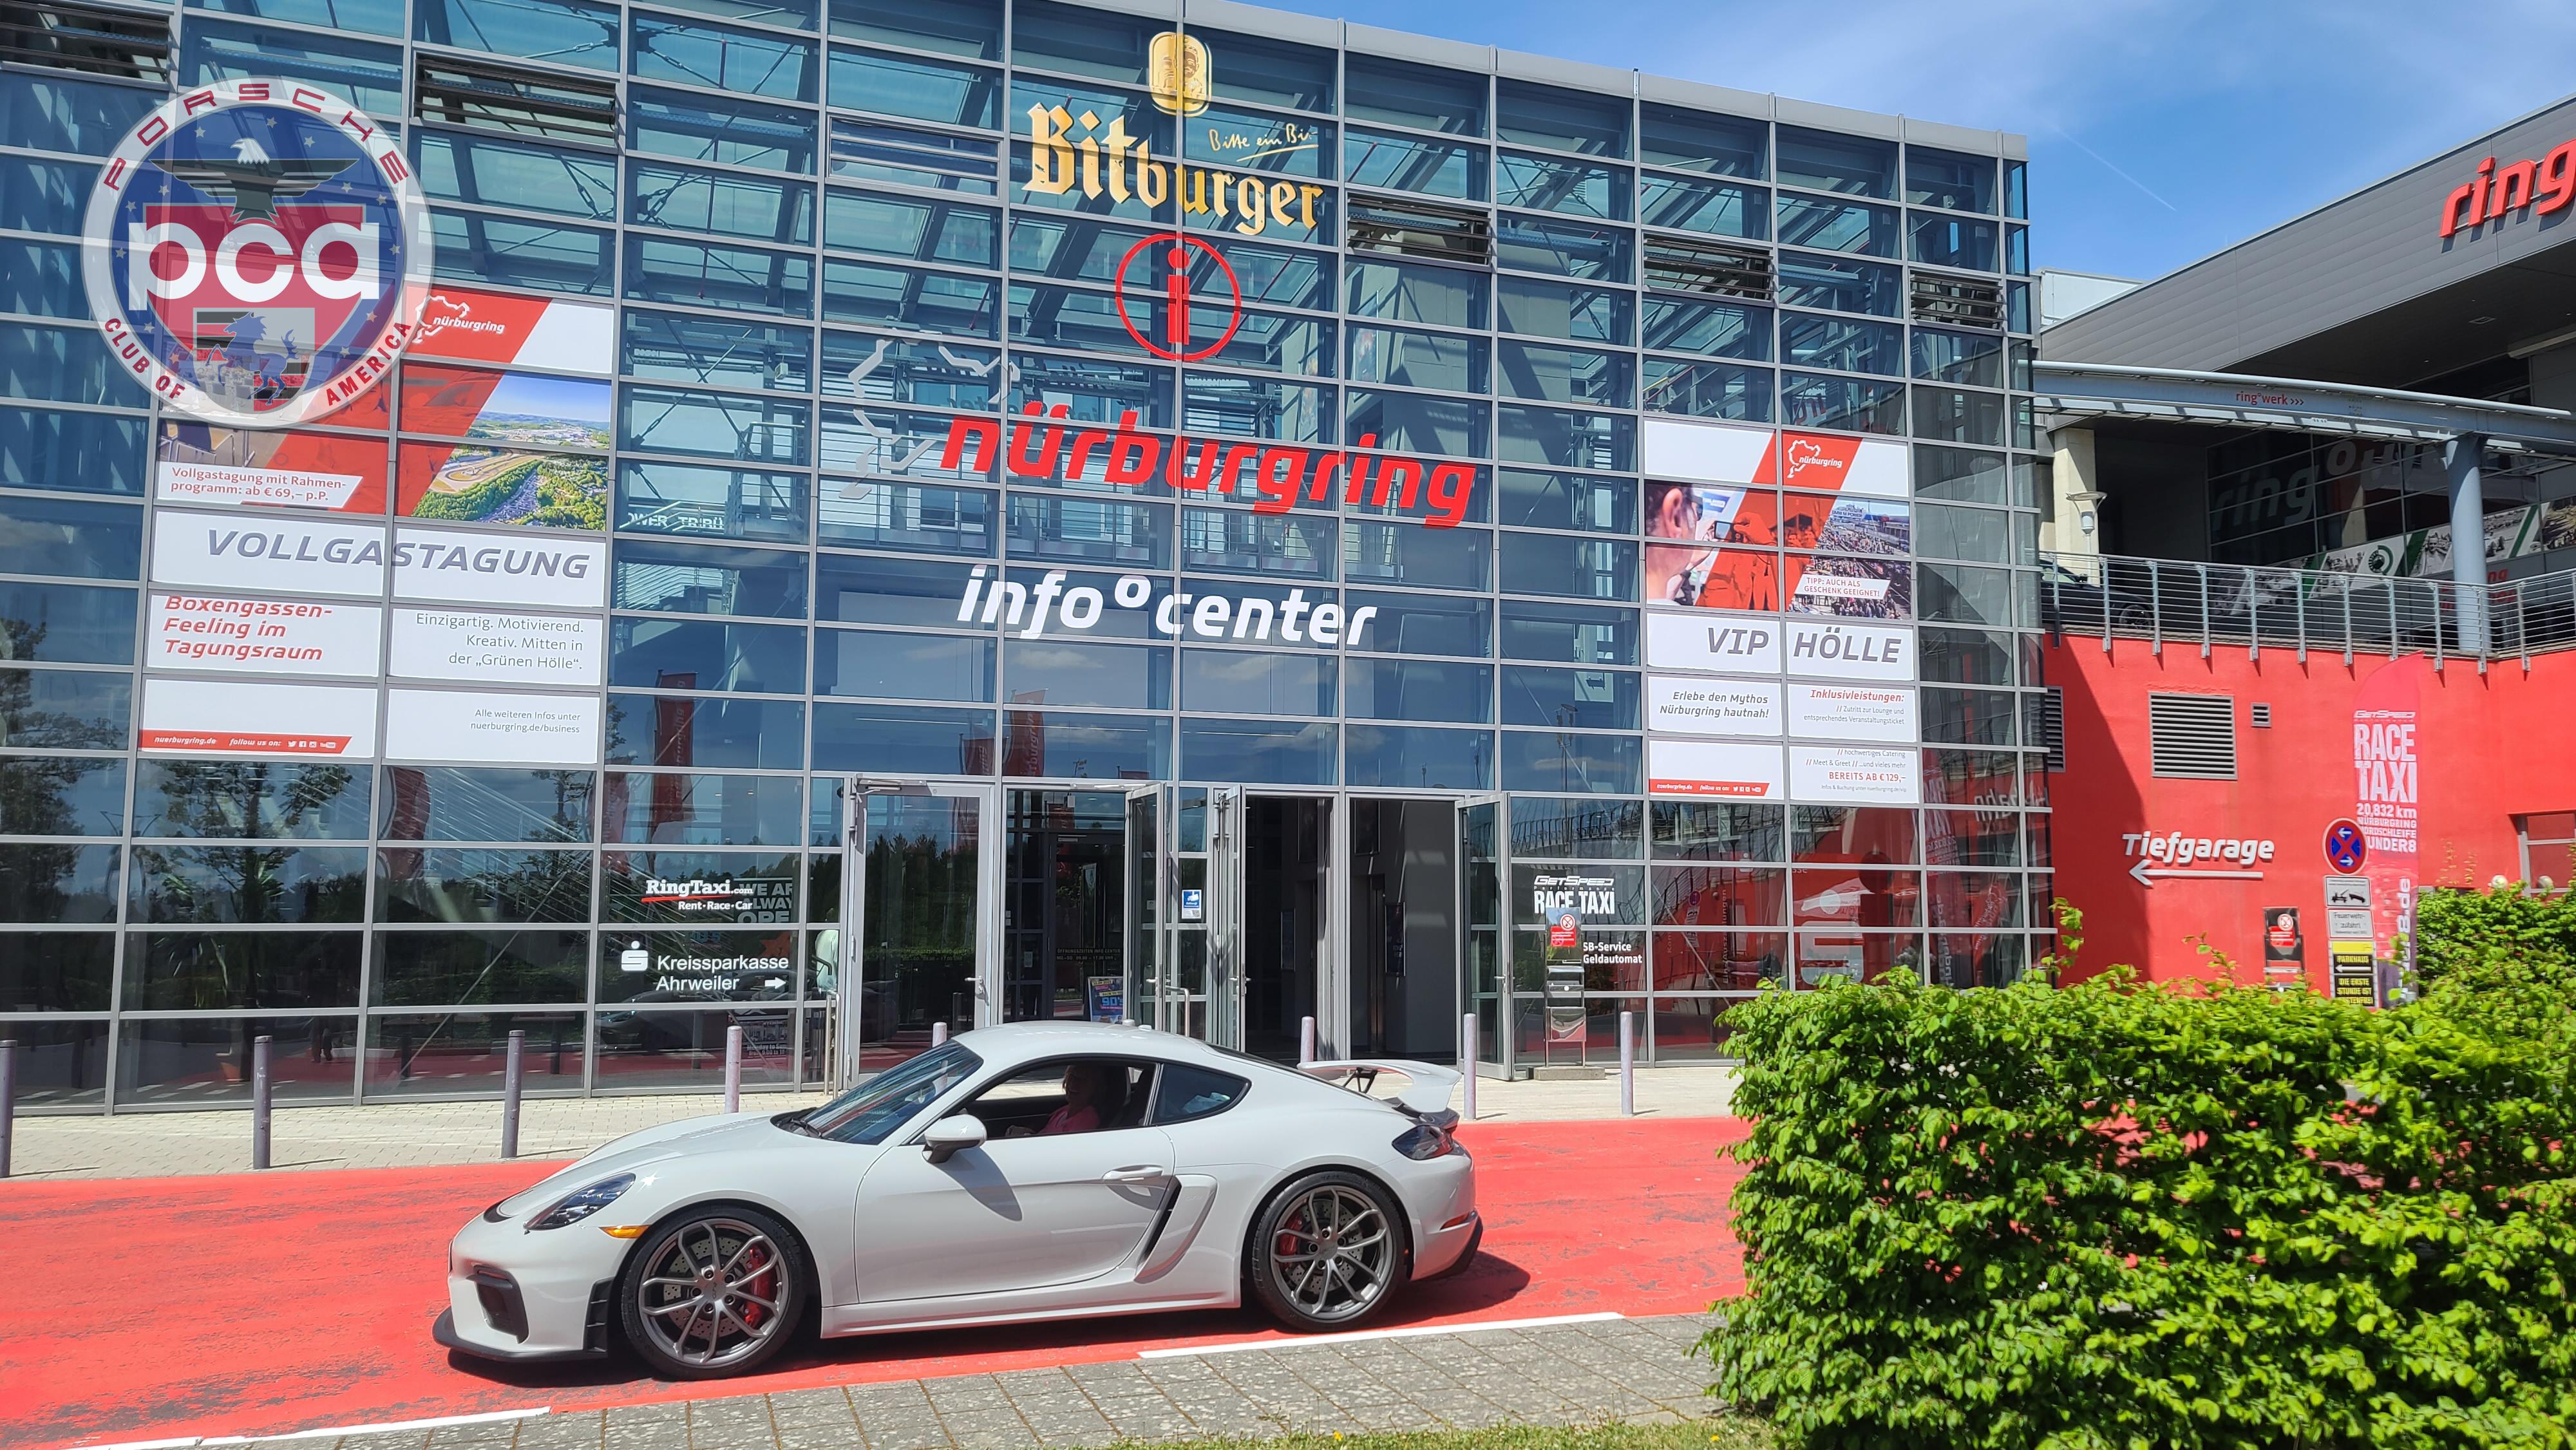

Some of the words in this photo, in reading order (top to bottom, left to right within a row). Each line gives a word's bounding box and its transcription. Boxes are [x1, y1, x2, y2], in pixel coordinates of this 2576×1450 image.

[1209, 129, 1250, 152] Bitte
[1256, 134, 1282, 146] ein
[1021, 102, 1324, 236] Bitburger
[433, 315, 506, 334] nürburgring
[940, 401, 1477, 529] nürburgring
[1799, 455, 1842, 468] nürburgring
[172, 467, 263, 485] Vollgastagung
[266, 475, 289, 485] mit
[291, 476, 346, 489] Rahmen-
[171, 481, 243, 496] programm:
[245, 484, 261, 496] ab
[264, 487, 272, 496] €
[305, 491, 329, 502] p.P.
[207, 529, 590, 579] VOLLGASTAGUNG
[1804, 585, 1842, 594] GESCHENK
[1843, 588, 1880, 597] GEEIGNET!
[164, 595, 333, 618] Boxengassen-
[163, 617, 251, 639] Feeling
[258, 619, 287, 637] im
[416, 613, 494, 631] Einzigartig.
[498, 618, 584, 633] Motivierend.
[165, 639, 323, 661] Tagungsraum
[466, 635, 517, 648] Kreativ.
[521, 637, 566, 650] Mitten
[571, 639, 583, 650] in
[1707, 627, 1770, 655] VIP
[1793, 626, 1902, 663] HÖLLE
[449, 652, 472, 665] der
[1672, 691, 1709, 702] Erlebe
[1709, 692, 1727, 702] den
[1730, 693, 1768, 706] Mythos
[1810, 690, 1905, 703] Inklusivleistungen:
[475, 709, 492, 718] Alle
[494, 710, 532, 719] weiteren
[535, 711, 555, 720] Infos
[558, 712, 581, 721] unter
[1660, 704, 1721, 719] Nürburgring
[1724, 706, 1769, 719] hautnah!
[470, 721, 580, 733] nuerburgring.de/business
[1849, 716, 1905, 724] Veranstaltungsticket
[154, 736, 217, 746] nuerburgring.de
[229, 738, 256, 747] follow
[2354, 724, 2416, 761] RACE
[1829, 771, 1863, 780] BEREITS
[2354, 761, 2417, 803] TAXI
[2396, 805, 2417, 818] km
[2123, 831, 2275, 867] Tiefgarage
[739, 883, 768, 896] WE
[678, 901, 702, 910] Rent
[706, 901, 730, 910] Race
[735, 901, 753, 910] Car
[1534, 890, 1574, 914] RACE
[1578, 891, 1615, 914] TAXI
[1583, 942, 1632, 952] SB-Service
[657, 954, 789, 974] Kreissparkasse
[1583, 954, 1643, 965] Geldautomat
[656, 975, 739, 991] Ahrweiler
